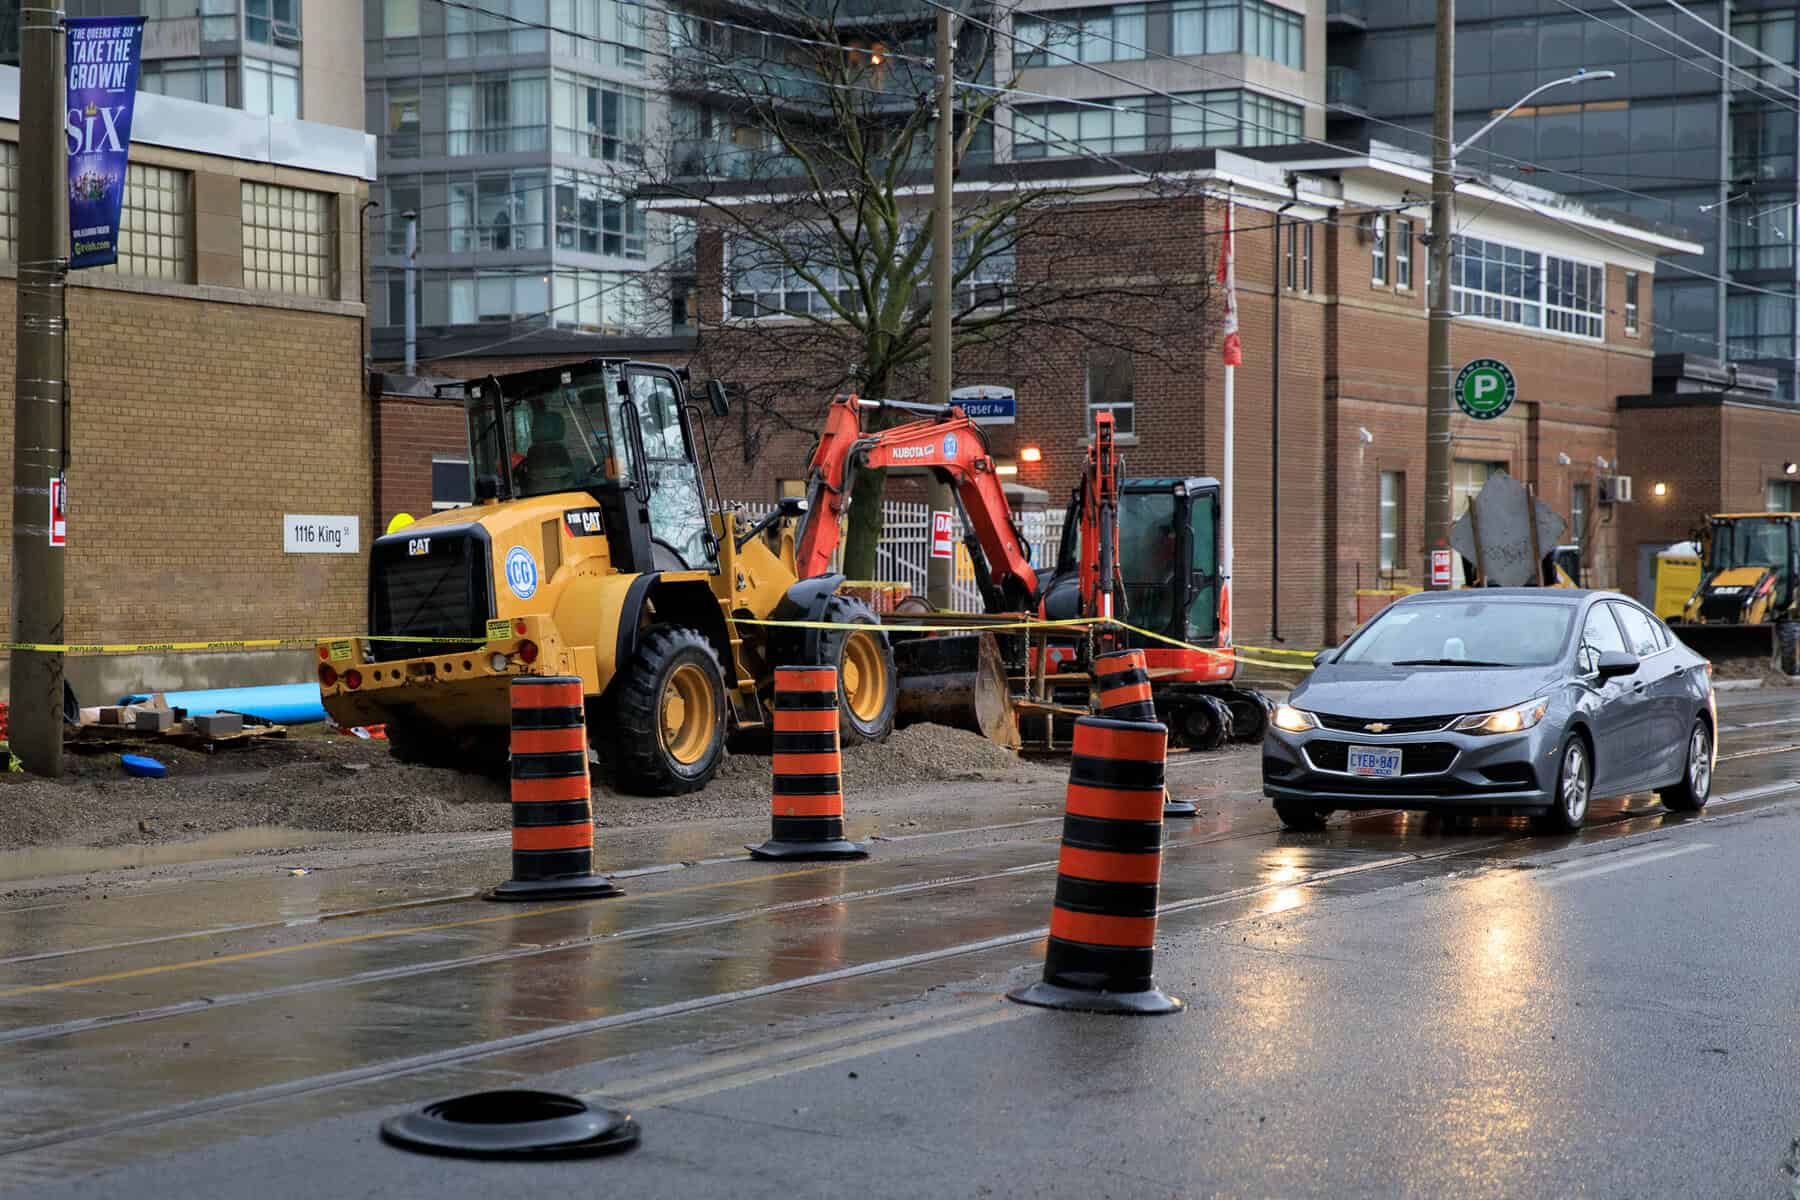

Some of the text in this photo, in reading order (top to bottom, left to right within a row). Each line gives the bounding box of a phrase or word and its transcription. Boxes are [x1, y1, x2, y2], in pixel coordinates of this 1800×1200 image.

[72, 28, 86, 40] THE
[112, 26, 122, 38] OF
[122, 26, 135, 37] SIX
[72, 39, 132, 63] TAKE THE
[70, 62, 130, 90] CROWN!
[1474, 375, 1497, 399] P
[962, 403, 1004, 415] Fraser Av
[892, 446, 924, 459] KUBOTA
[582, 511, 600, 532] CAT
[295, 525, 315, 542] 1116
[318, 525, 341, 547] King
[408, 538, 431, 556] CAT
